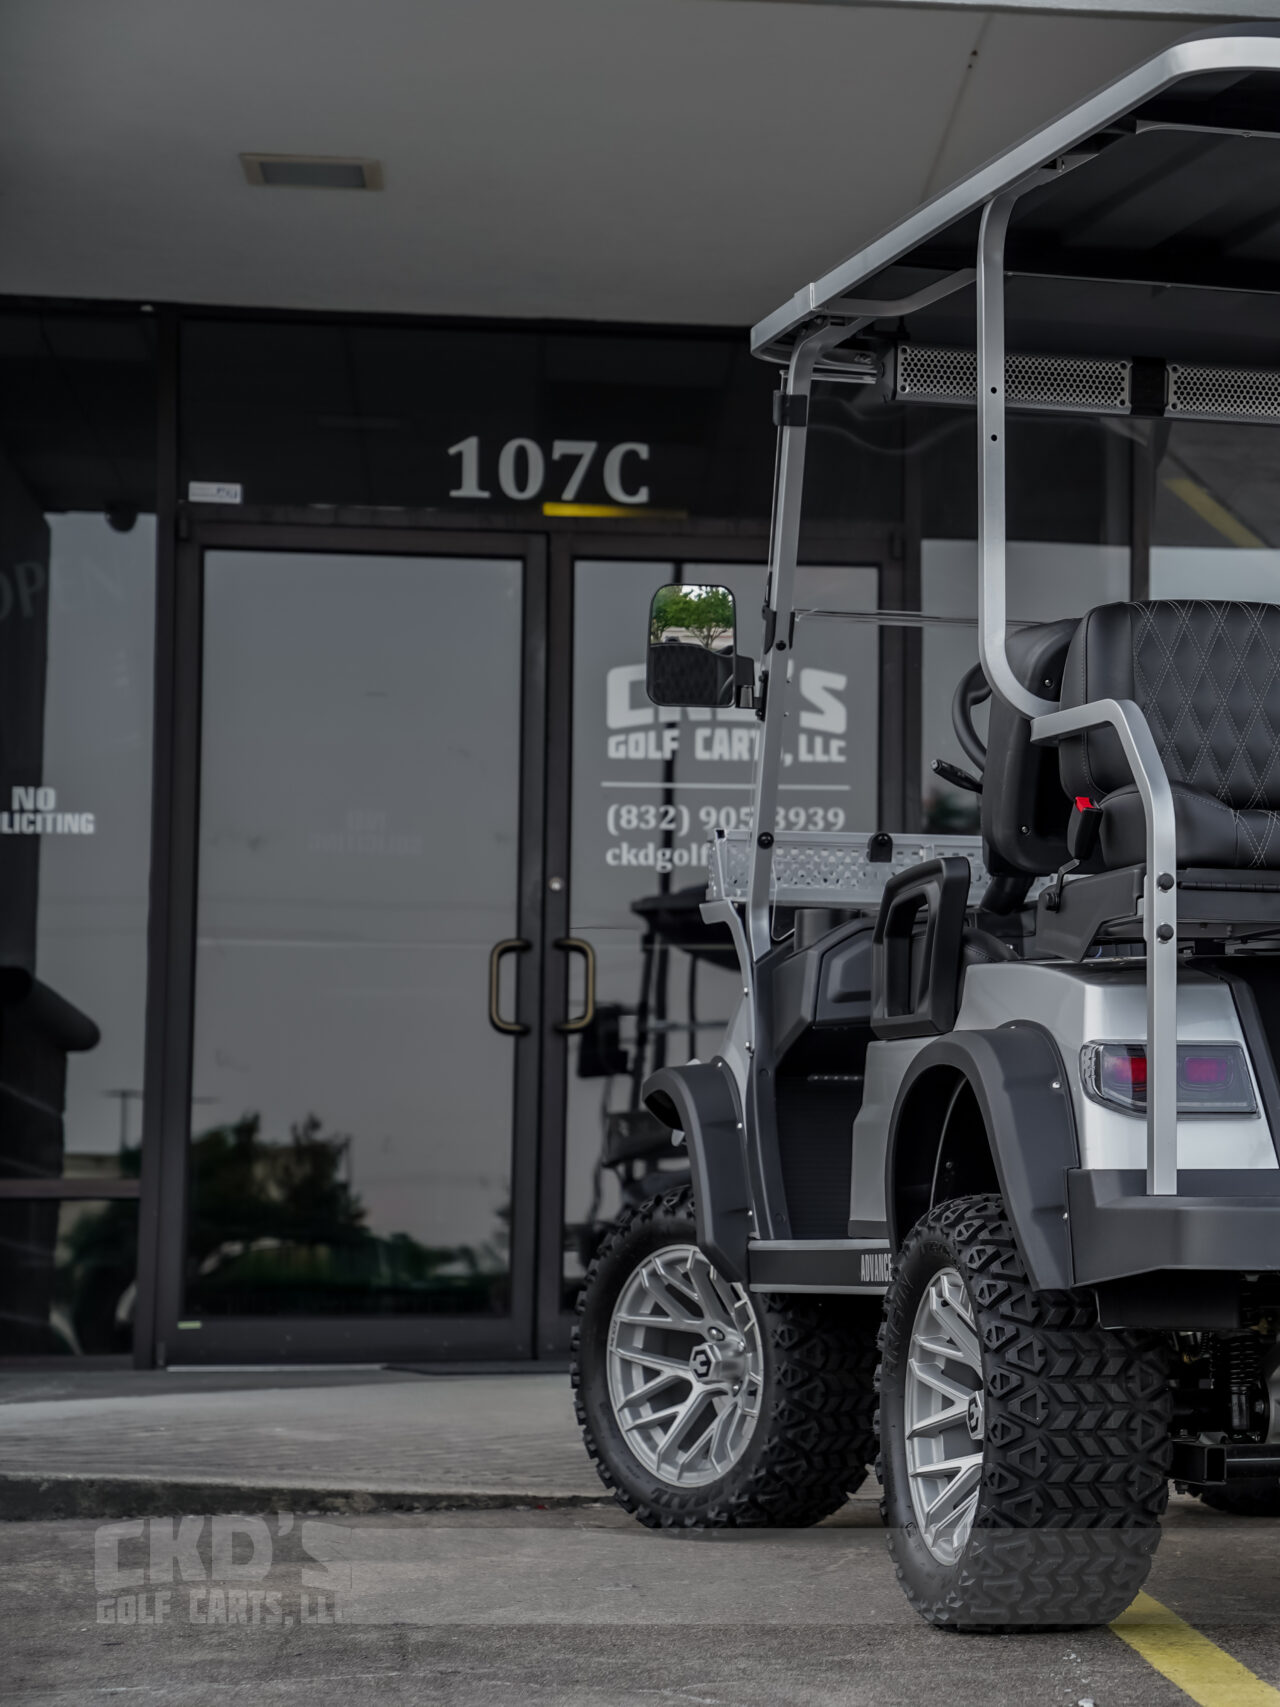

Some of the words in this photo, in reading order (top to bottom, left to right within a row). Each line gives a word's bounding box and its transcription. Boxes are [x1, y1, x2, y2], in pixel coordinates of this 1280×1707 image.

[448, 436, 650, 504] 107C
[606, 658, 847, 735] C'S
[607, 728, 681, 760] GOLF
[12, 785, 56, 811] NO
[606, 803, 690, 836] (832)
[699, 805, 846, 832] 9053939
